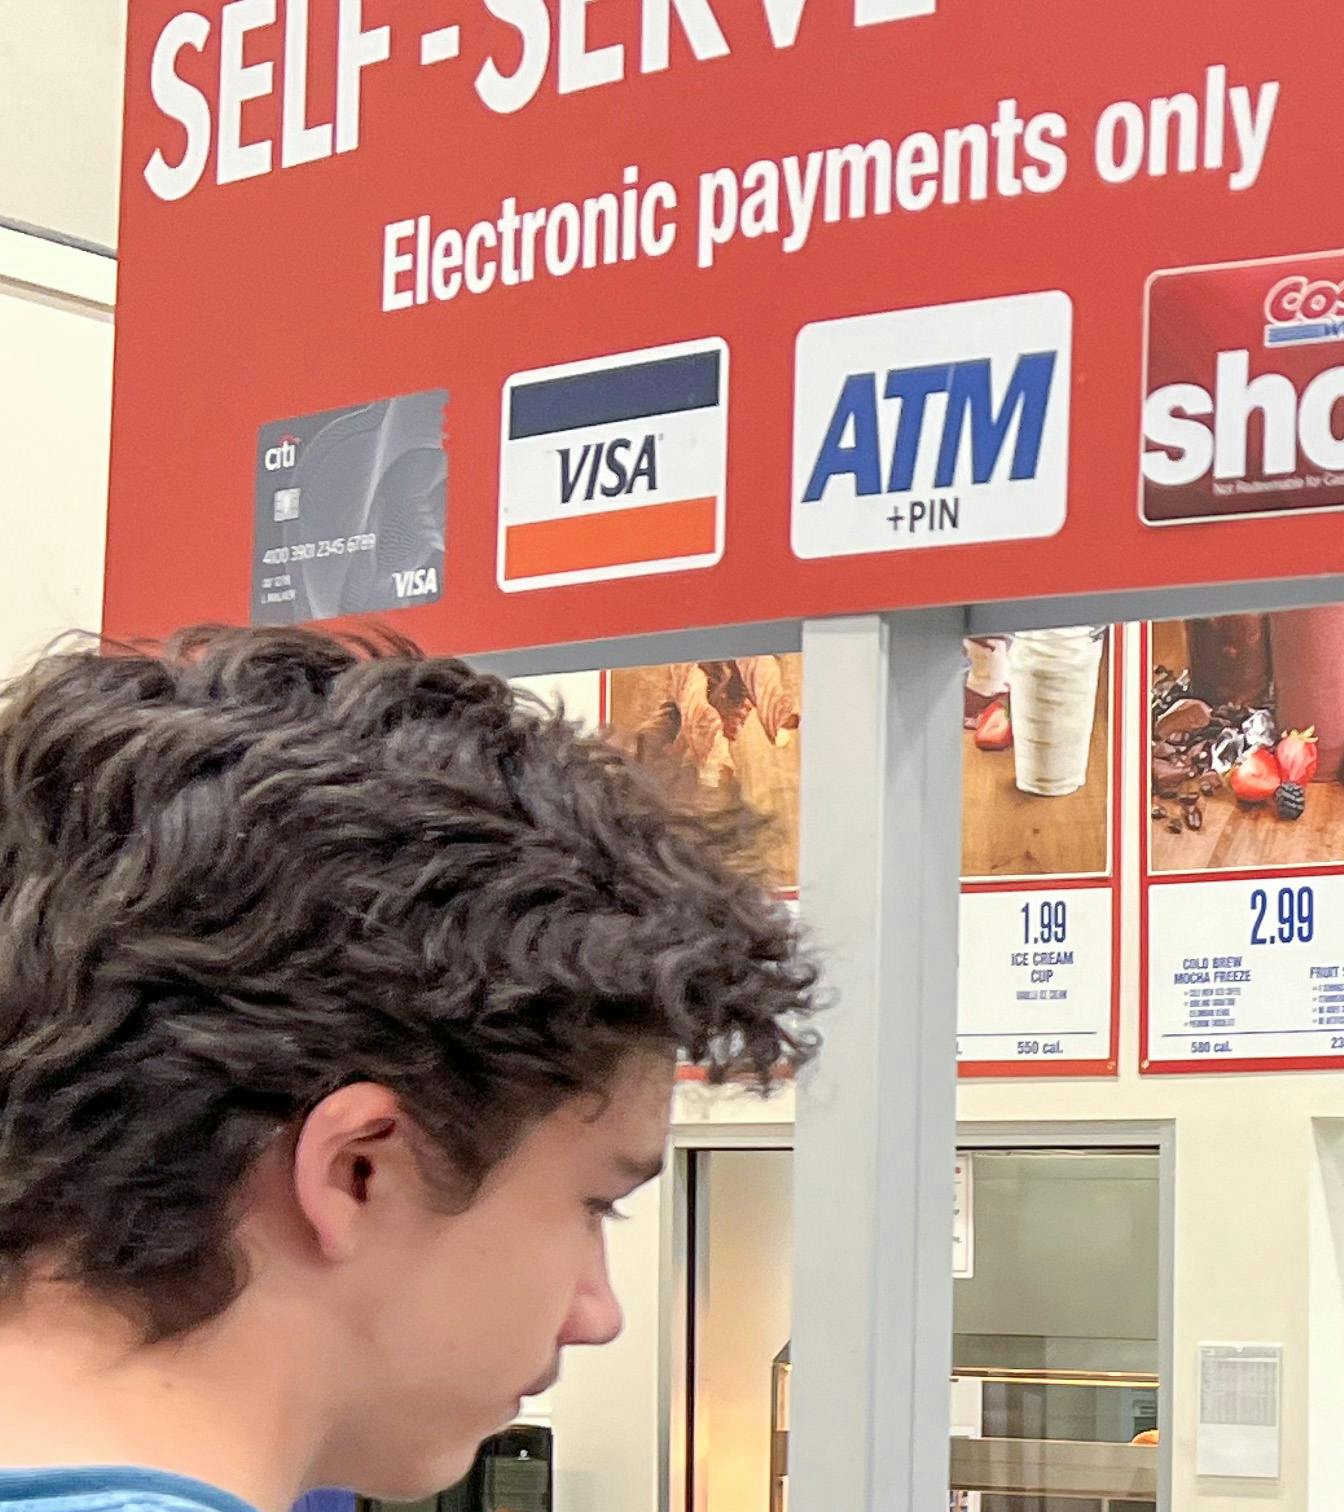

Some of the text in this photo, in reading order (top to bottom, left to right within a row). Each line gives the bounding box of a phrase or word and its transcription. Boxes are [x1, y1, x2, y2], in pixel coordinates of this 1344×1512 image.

[382, 64, 1280, 312] Electronic payments only
[801, 350, 1057, 505] ATM
[265, 440, 296, 471] citi
[555, 436, 660, 505] VISA
[886, 497, 961, 536] +PIN
[392, 567, 438, 598] VISA
[1021, 900, 1067, 944] 1.99
[1249, 886, 1315, 945] 2.99
[1011, 951, 1074, 966] ICE CREAM
[1183, 956, 1242, 969] COLD BREW
[1310, 966, 1339, 978] FRUIT
[1030, 969, 1054, 983] CUP
[1174, 970, 1251, 984] MOCHA FREEZE
[1017, 1040, 1064, 1054] 550 cal.
